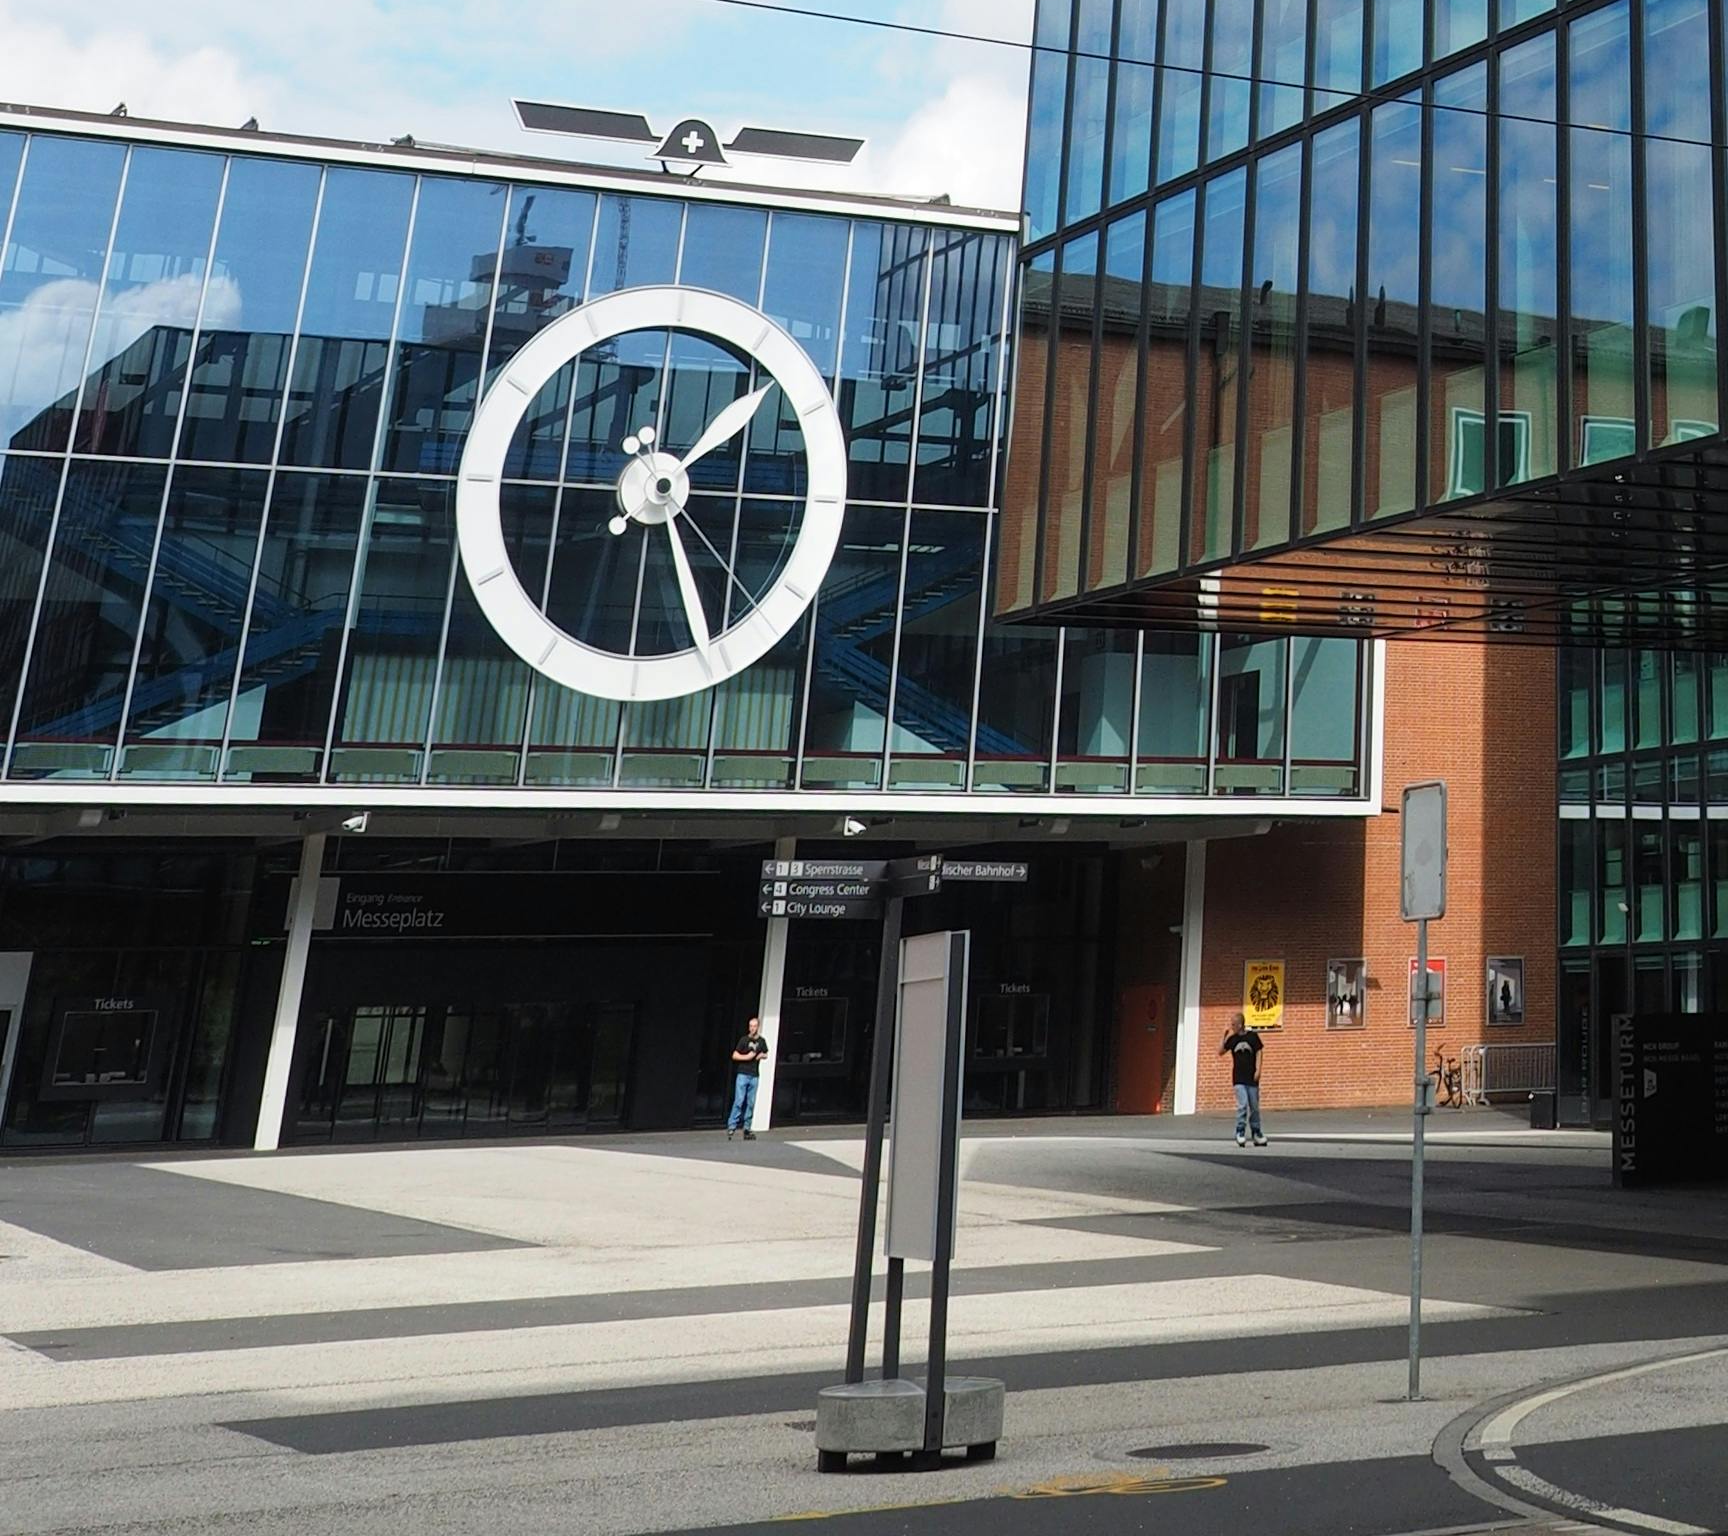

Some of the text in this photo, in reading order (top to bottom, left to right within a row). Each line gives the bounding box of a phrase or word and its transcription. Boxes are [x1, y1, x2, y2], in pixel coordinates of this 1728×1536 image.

[804, 863, 864, 877] Sperrstrasse
[975, 864, 1015, 877] Bahnhof
[788, 883, 835, 898] Congress
[836, 883, 871, 896] Center
[346, 892, 385, 906] Eingang
[786, 902, 807, 917] City
[808, 903, 846, 917] Lounge
[343, 907, 445, 933] Messeplatz
[796, 986, 829, 998] Tickets
[1000, 982, 1031, 994] Tickets
[95, 997, 135, 1010] Tickets
[1619, 1013, 1636, 1172] MESSETURM
